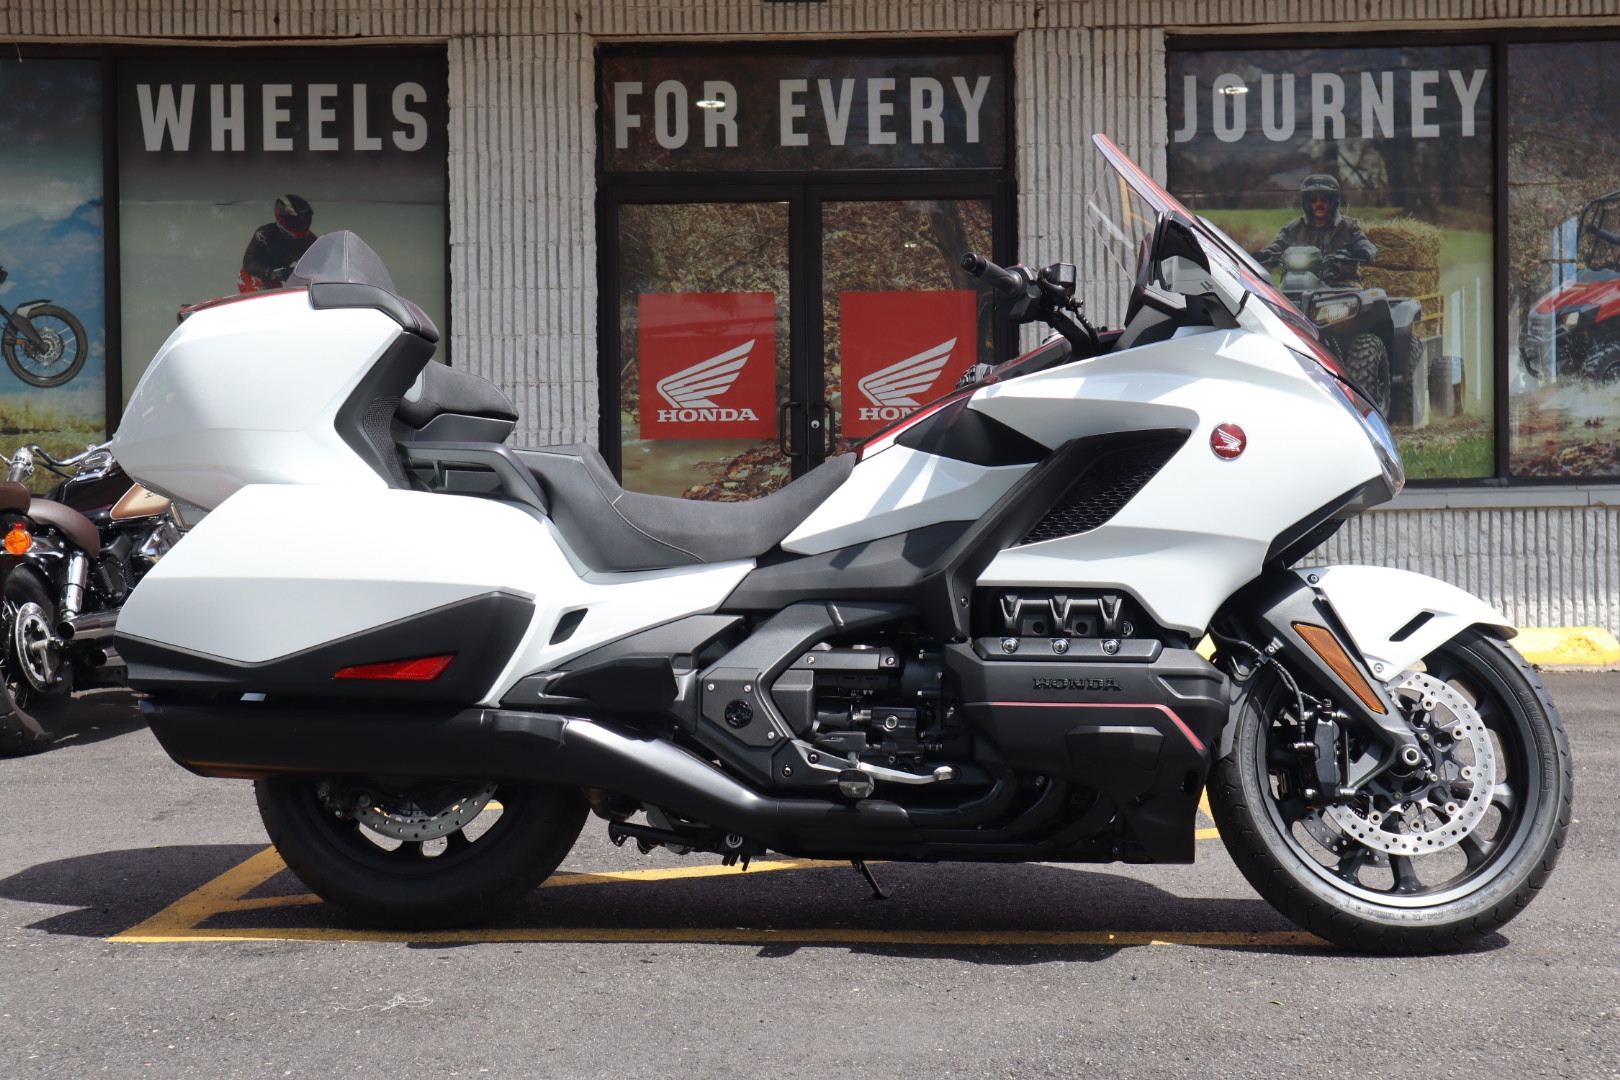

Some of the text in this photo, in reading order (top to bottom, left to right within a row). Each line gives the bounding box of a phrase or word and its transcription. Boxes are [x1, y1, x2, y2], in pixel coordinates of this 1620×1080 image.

[136, 82, 428, 152] WHEELS
[613, 76, 991, 149] FOR EVERY
[1174, 69, 1487, 142] JOURNEY
[657, 408, 760, 423] HONDA
[1032, 677, 1122, 691] HONDA
